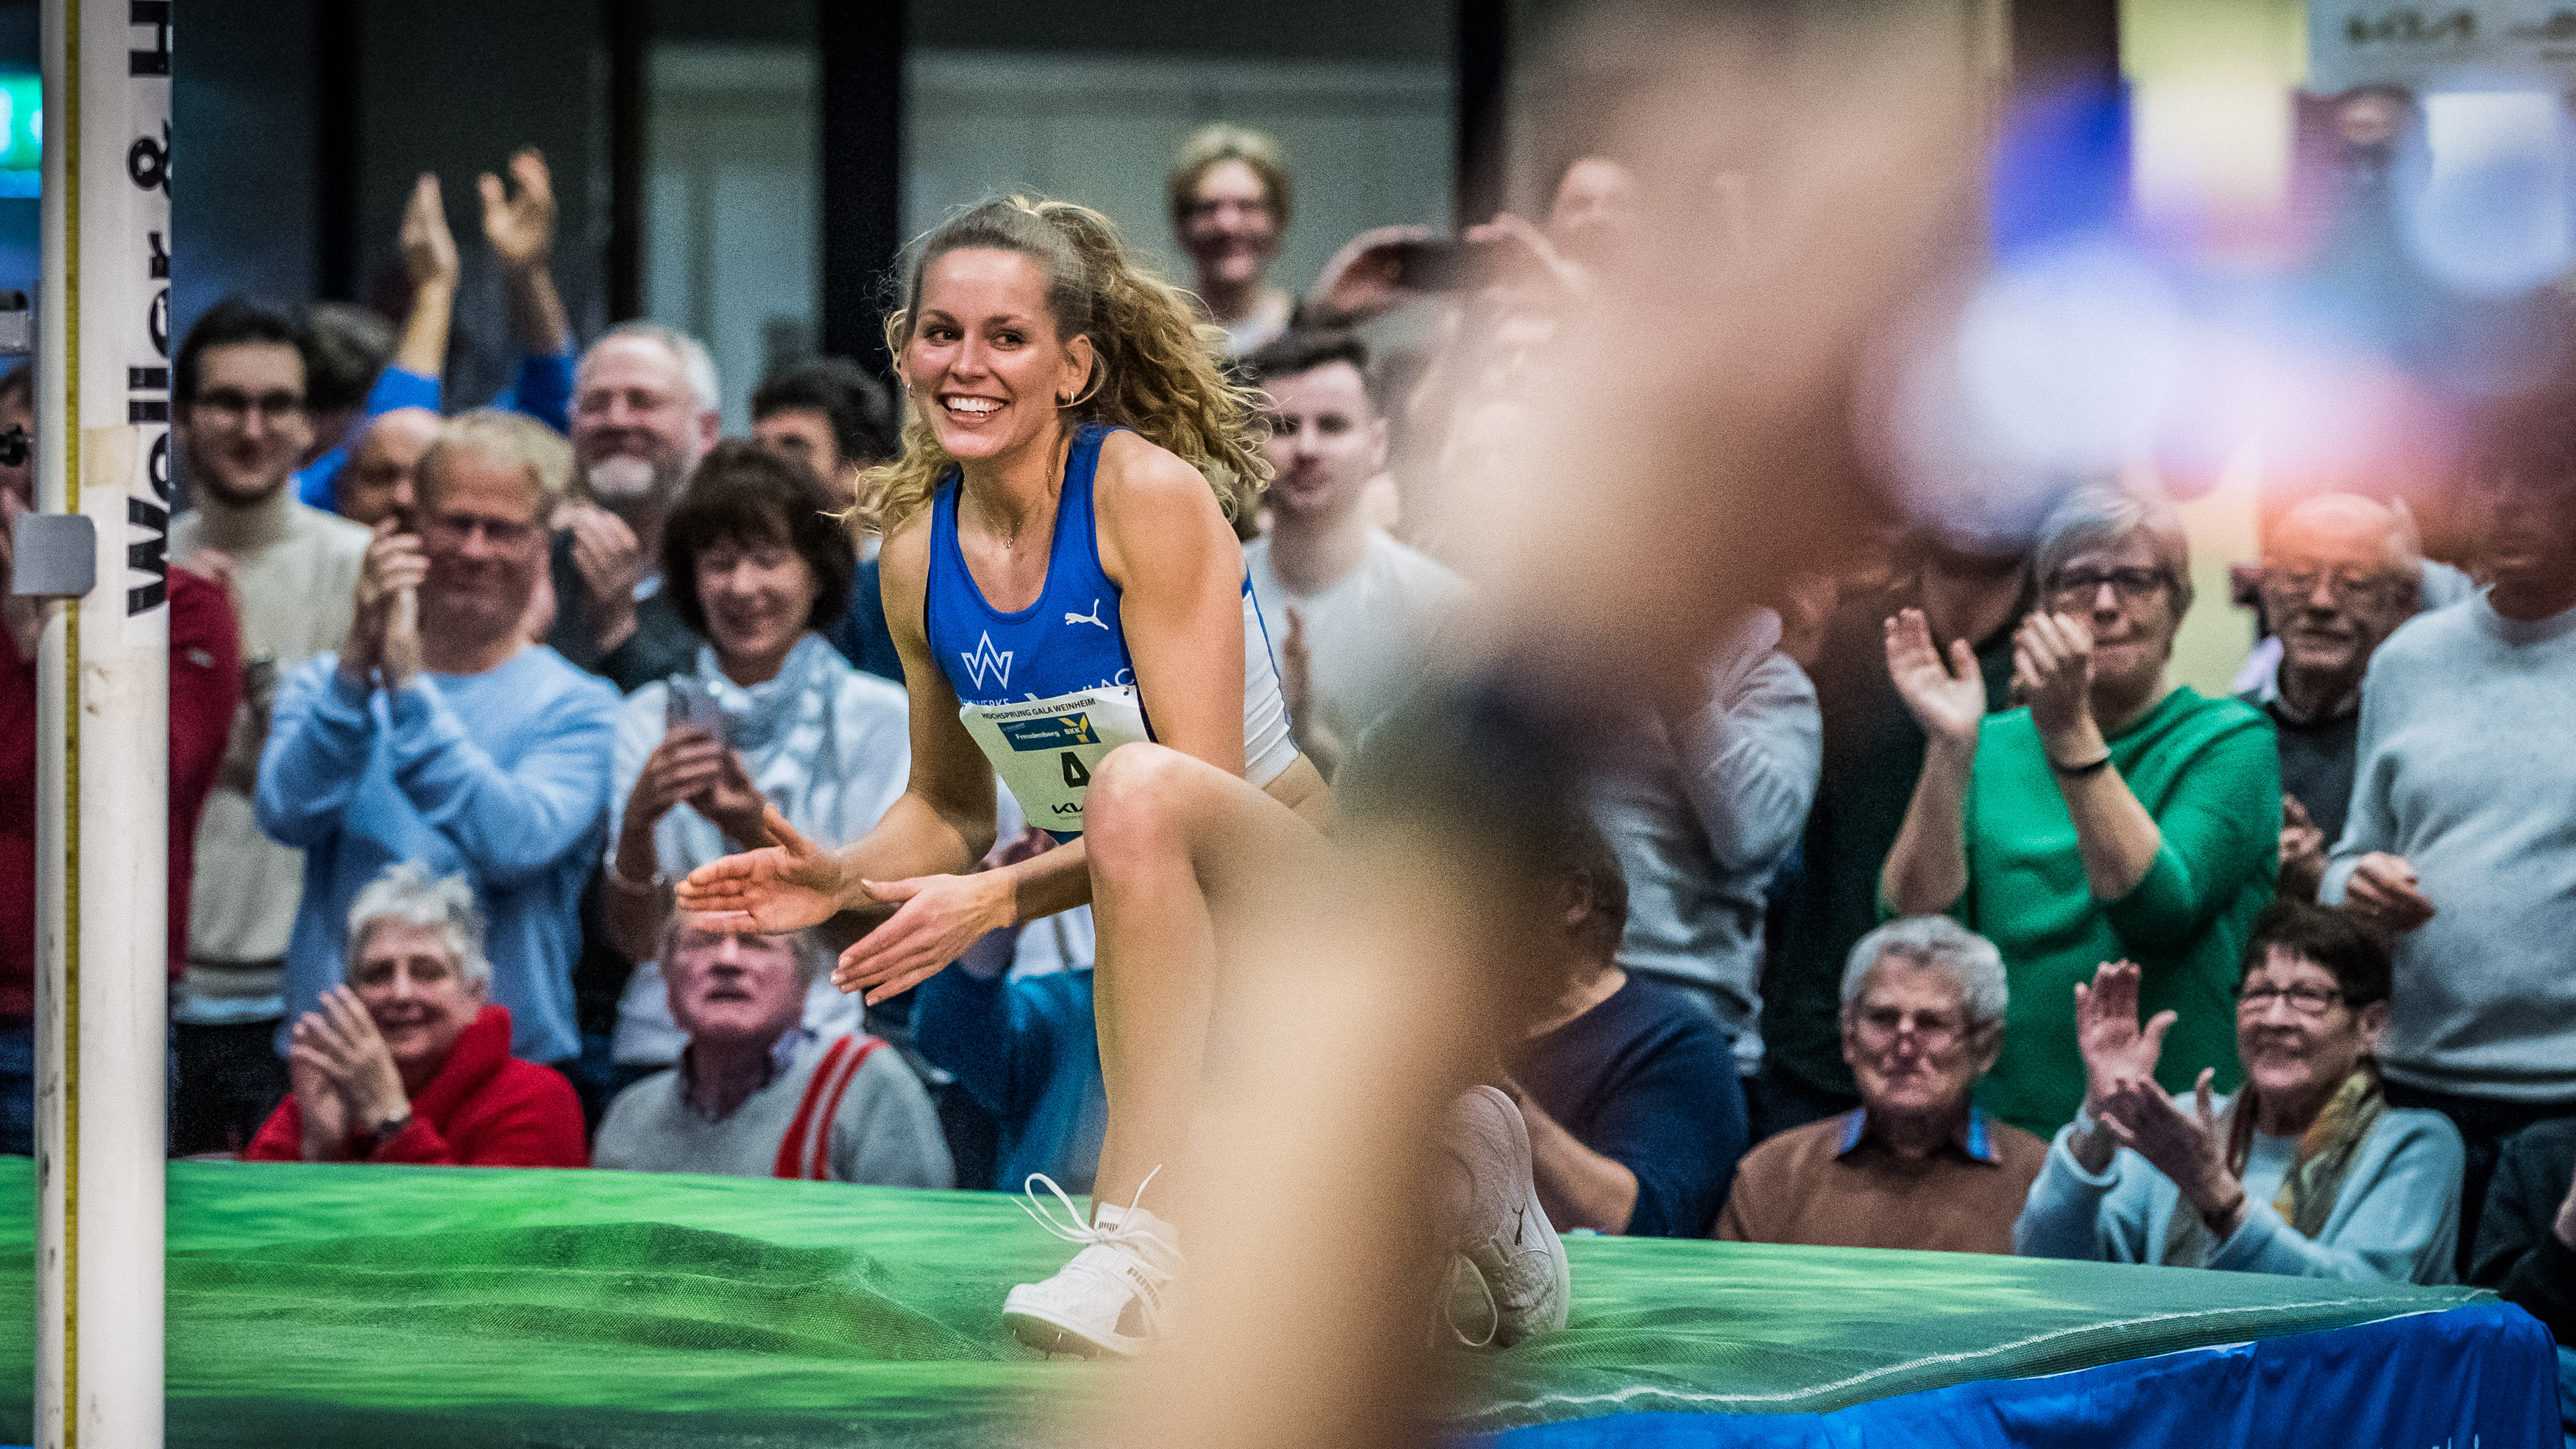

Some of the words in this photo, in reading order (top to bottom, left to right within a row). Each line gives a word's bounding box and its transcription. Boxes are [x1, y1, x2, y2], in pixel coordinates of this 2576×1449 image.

[981, 709, 1032, 720] HOCHSPRUNG
[1032, 706, 1054, 715] GALA
[1052, 698, 1096, 712] WEINHEIM
[1015, 731, 1061, 740] Freudenberg
[1064, 727, 1082, 735] BKK
[1061, 751, 1091, 788] 4
